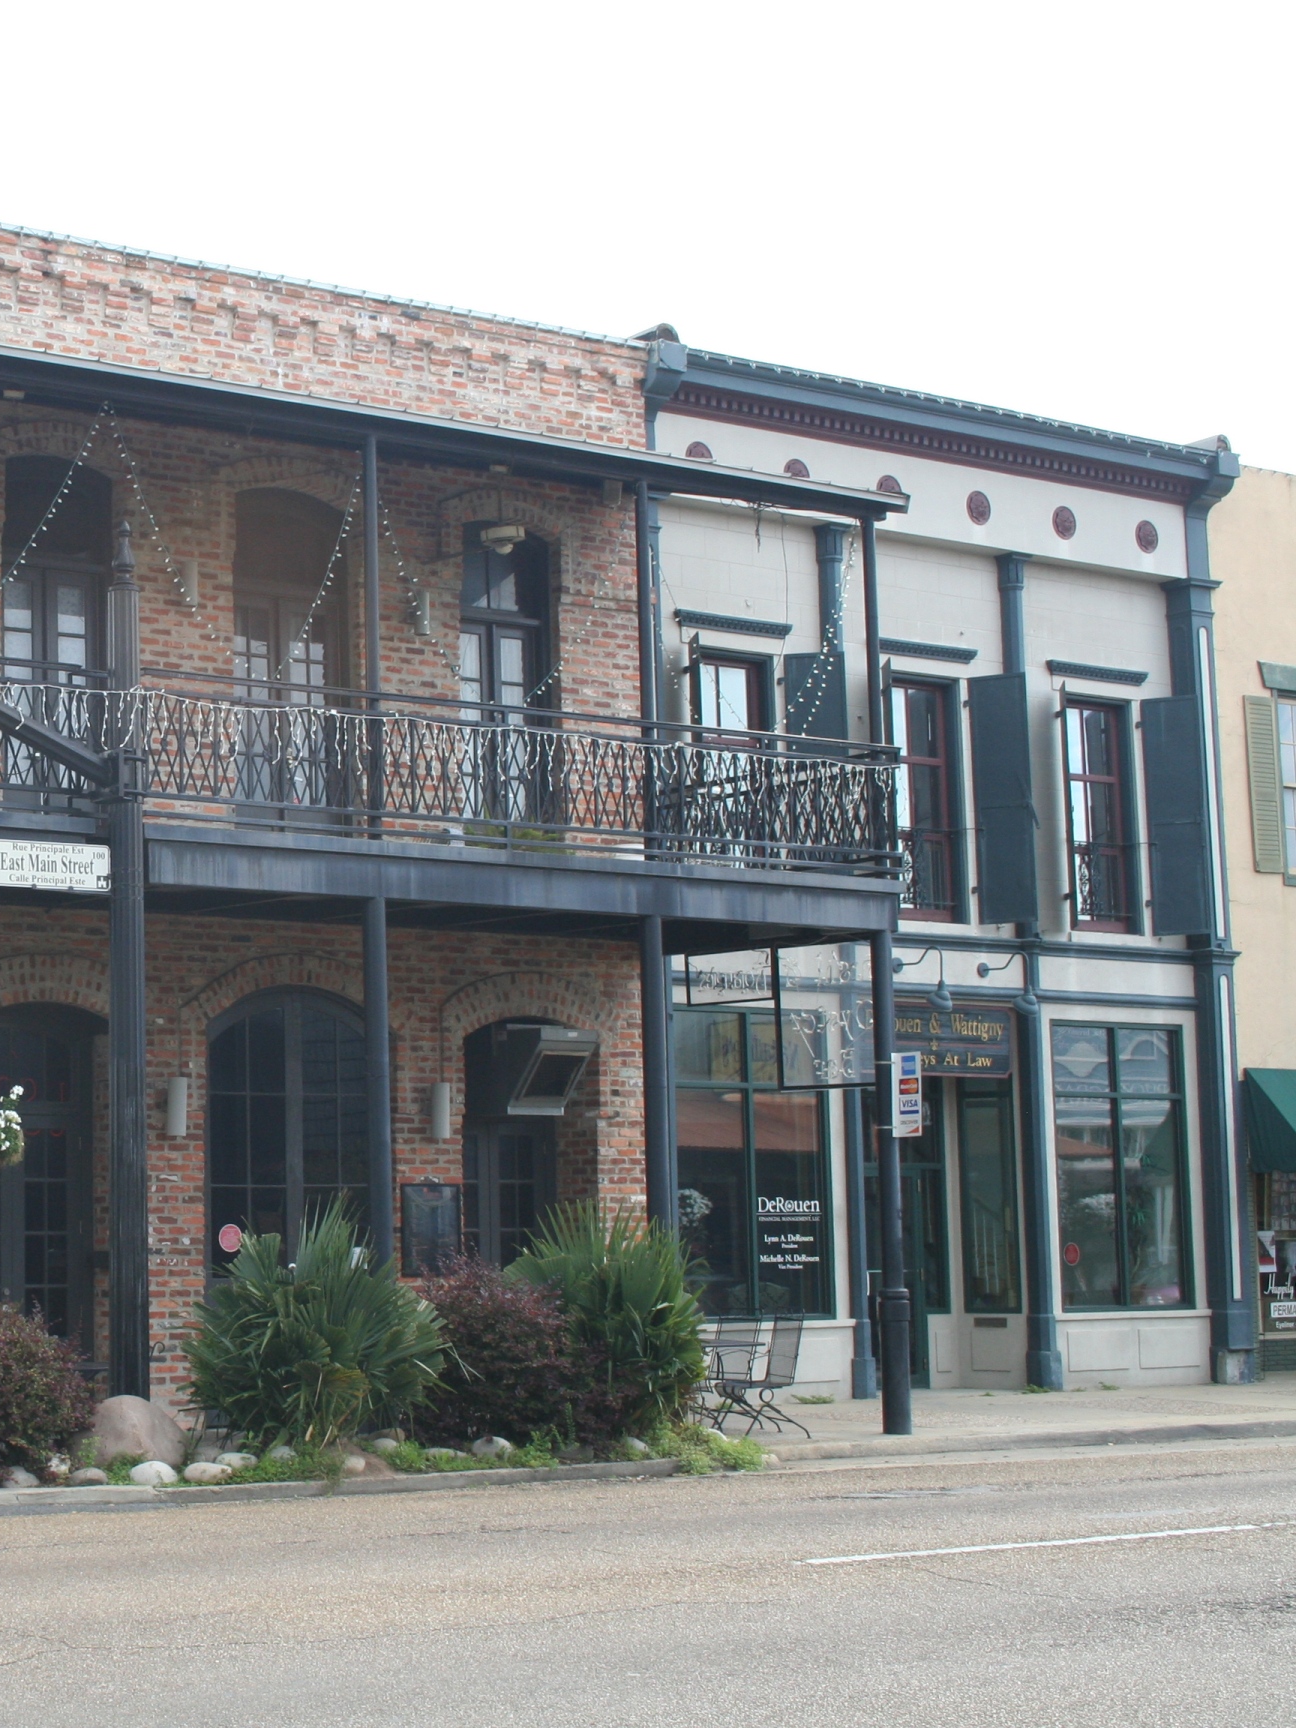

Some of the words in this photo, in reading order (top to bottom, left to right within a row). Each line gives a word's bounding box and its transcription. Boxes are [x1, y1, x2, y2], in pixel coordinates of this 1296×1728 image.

[12, 842, 28, 851] Rue
[30, 844, 70, 855] Principale
[71, 846, 84, 854] Est
[92, 851, 105, 860] 100
[0, 852, 25, 871] East
[28, 854, 58, 873] Main
[61, 855, 94, 875] Street
[9, 873, 29, 883] Calle
[31, 875, 67, 886] Principal
[69, 877, 86, 885] Este
[929, 1012, 941, 1034] &
[950, 1013, 1004, 1041] Wattigny
[944, 1051, 959, 1066] At
[967, 1052, 993, 1067] Law
[902, 1098, 918, 1108] VISA
[757, 1196, 821, 1213] DeRouen
[764, 1234, 779, 1245] Lynn
[787, 1233, 814, 1242] DeRouen
[759, 1254, 784, 1263] Michelle
[793, 1254, 820, 1262] DeRouen
[1264, 1272, 1294, 1300] Happily
[1275, 1321, 1295, 1330] Eyeliner
